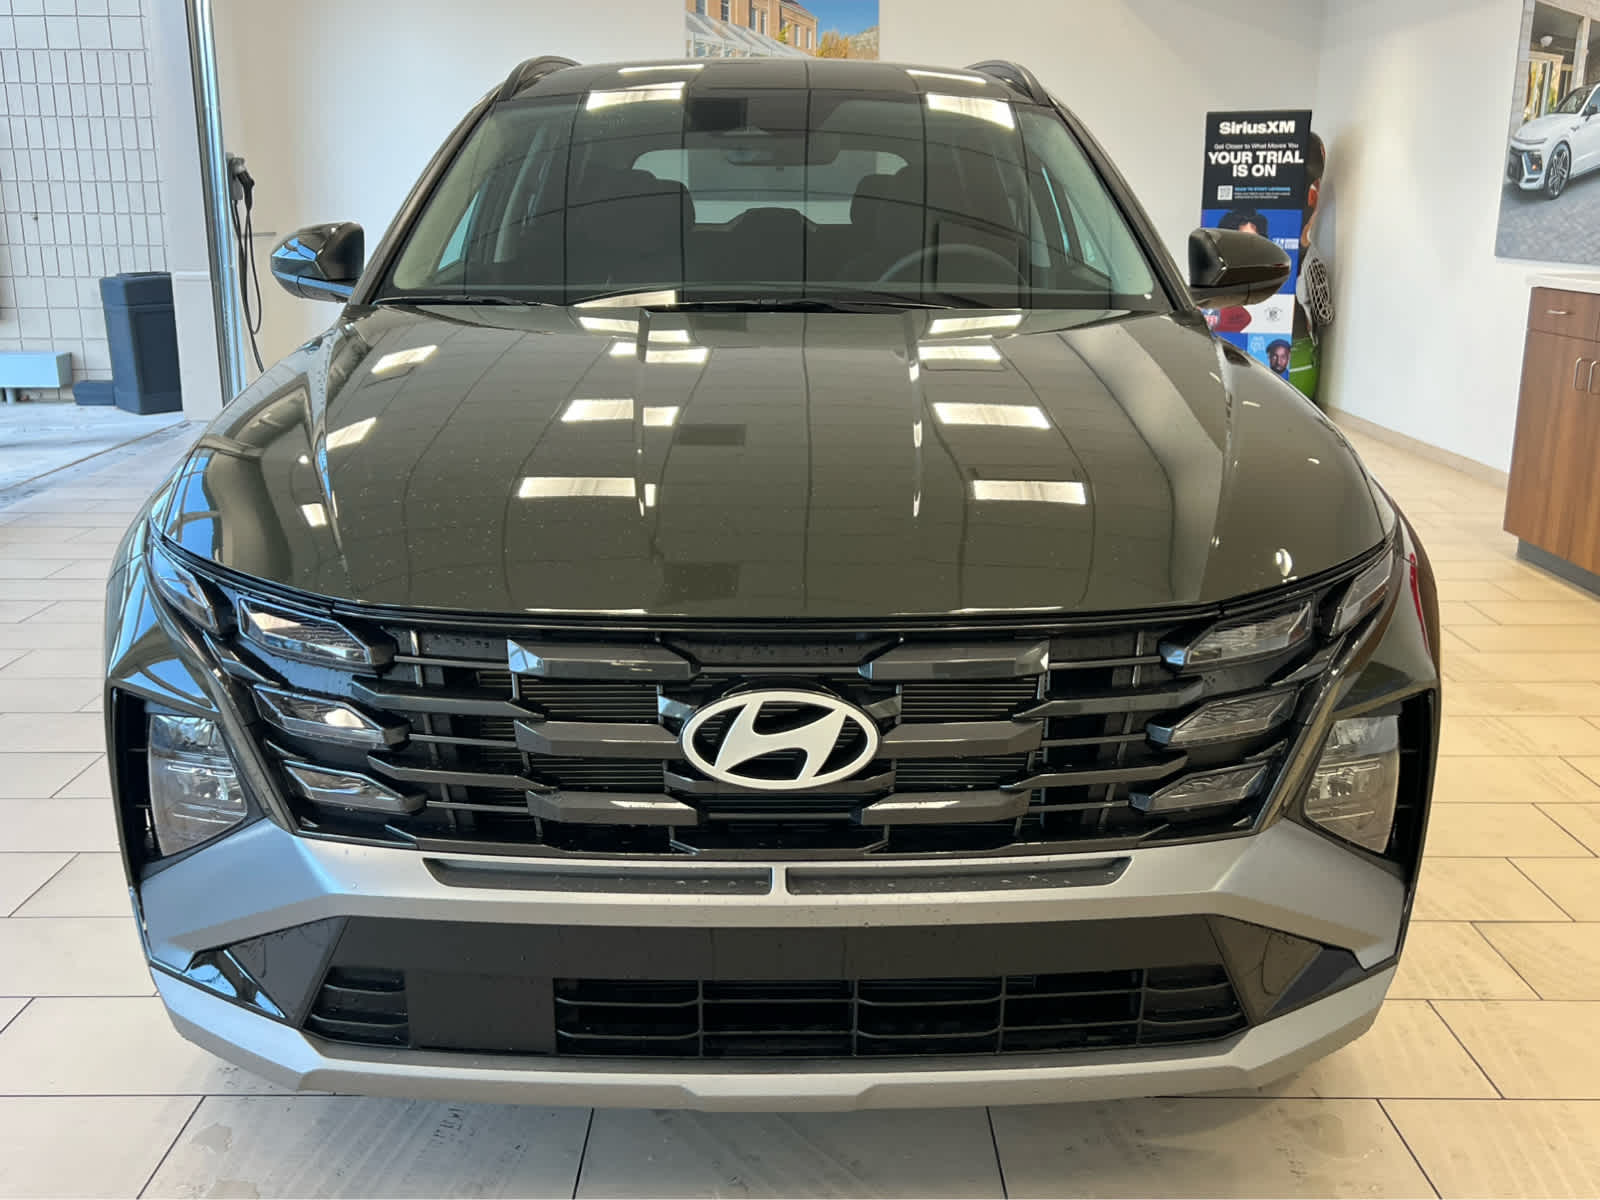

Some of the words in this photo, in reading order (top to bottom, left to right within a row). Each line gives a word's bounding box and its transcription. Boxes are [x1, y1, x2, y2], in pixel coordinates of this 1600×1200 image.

[1218, 120, 1296, 135] SiriusXM
[1207, 151, 1253, 165] YOUR
[1256, 150, 1304, 164] TRIAL
[1232, 164, 1248, 177] IS
[1251, 164, 1277, 177] ON
